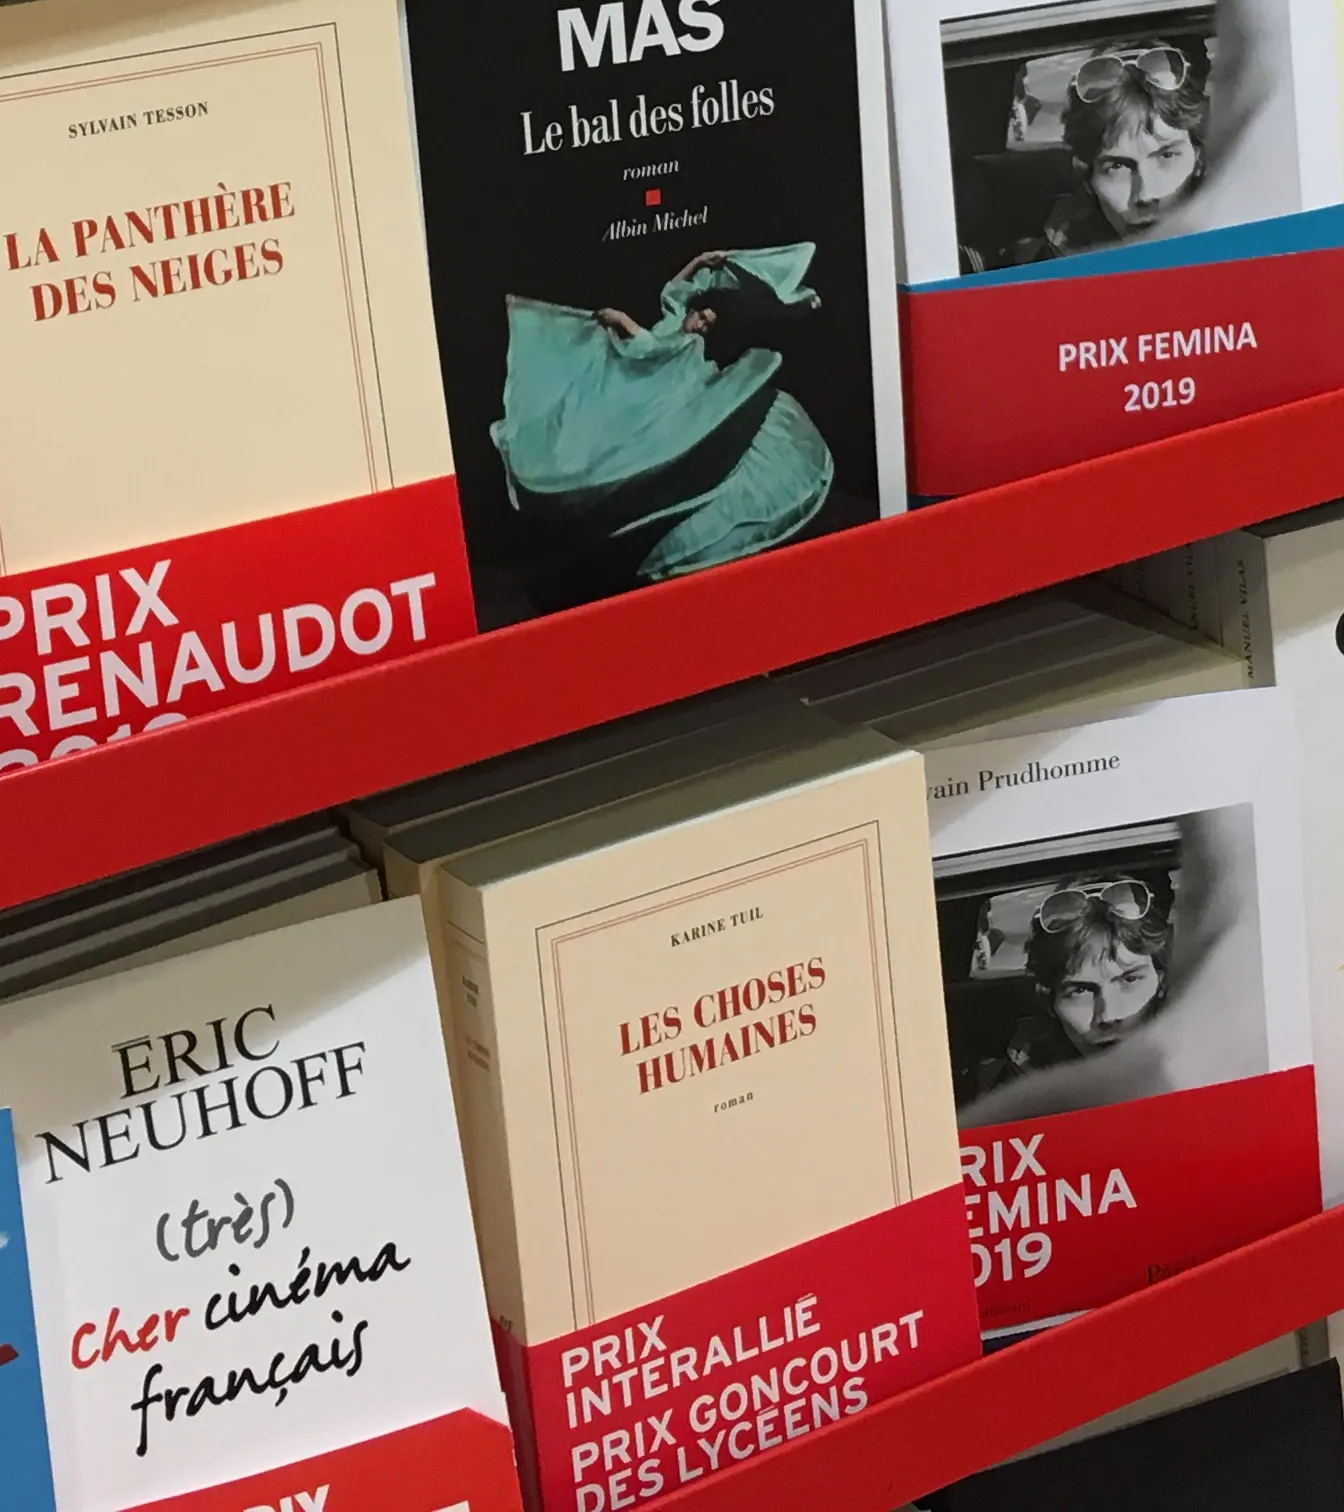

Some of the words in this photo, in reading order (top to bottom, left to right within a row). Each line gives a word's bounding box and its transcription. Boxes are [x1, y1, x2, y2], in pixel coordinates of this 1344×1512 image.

[520, 109, 564, 156] Le
[569, 99, 622, 149] bal
[629, 94, 684, 140] des
[690, 78, 775, 131] folles
[622, 157, 680, 182] roman
[602, 218, 648, 242] Albin
[652, 205, 709, 235] Michel
[1058, 337, 1129, 372] PRIX
[1138, 321, 1258, 363] FEMINA
[1123, 377, 1197, 412] 2019
[977, 751, 1121, 794] Prudhomme
[670, 918, 727, 948] KARINE
[730, 906, 764, 929] TUIL
[35, 1041, 367, 1185] NEUHOFF
[714, 1091, 755, 1114] roman
[156, 1178, 295, 1262] (très)
[204, 1241, 412, 1331] cinéma
[130, 1310, 369, 1457] français
[561, 1315, 667, 1388] PRIX
[565, 1293, 822, 1431] INTERALLIÉ
[569, 1416, 678, 1484] PRIX
[688, 1309, 924, 1433] GONCOURT
[676, 1375, 870, 1487] LYCÉENS
